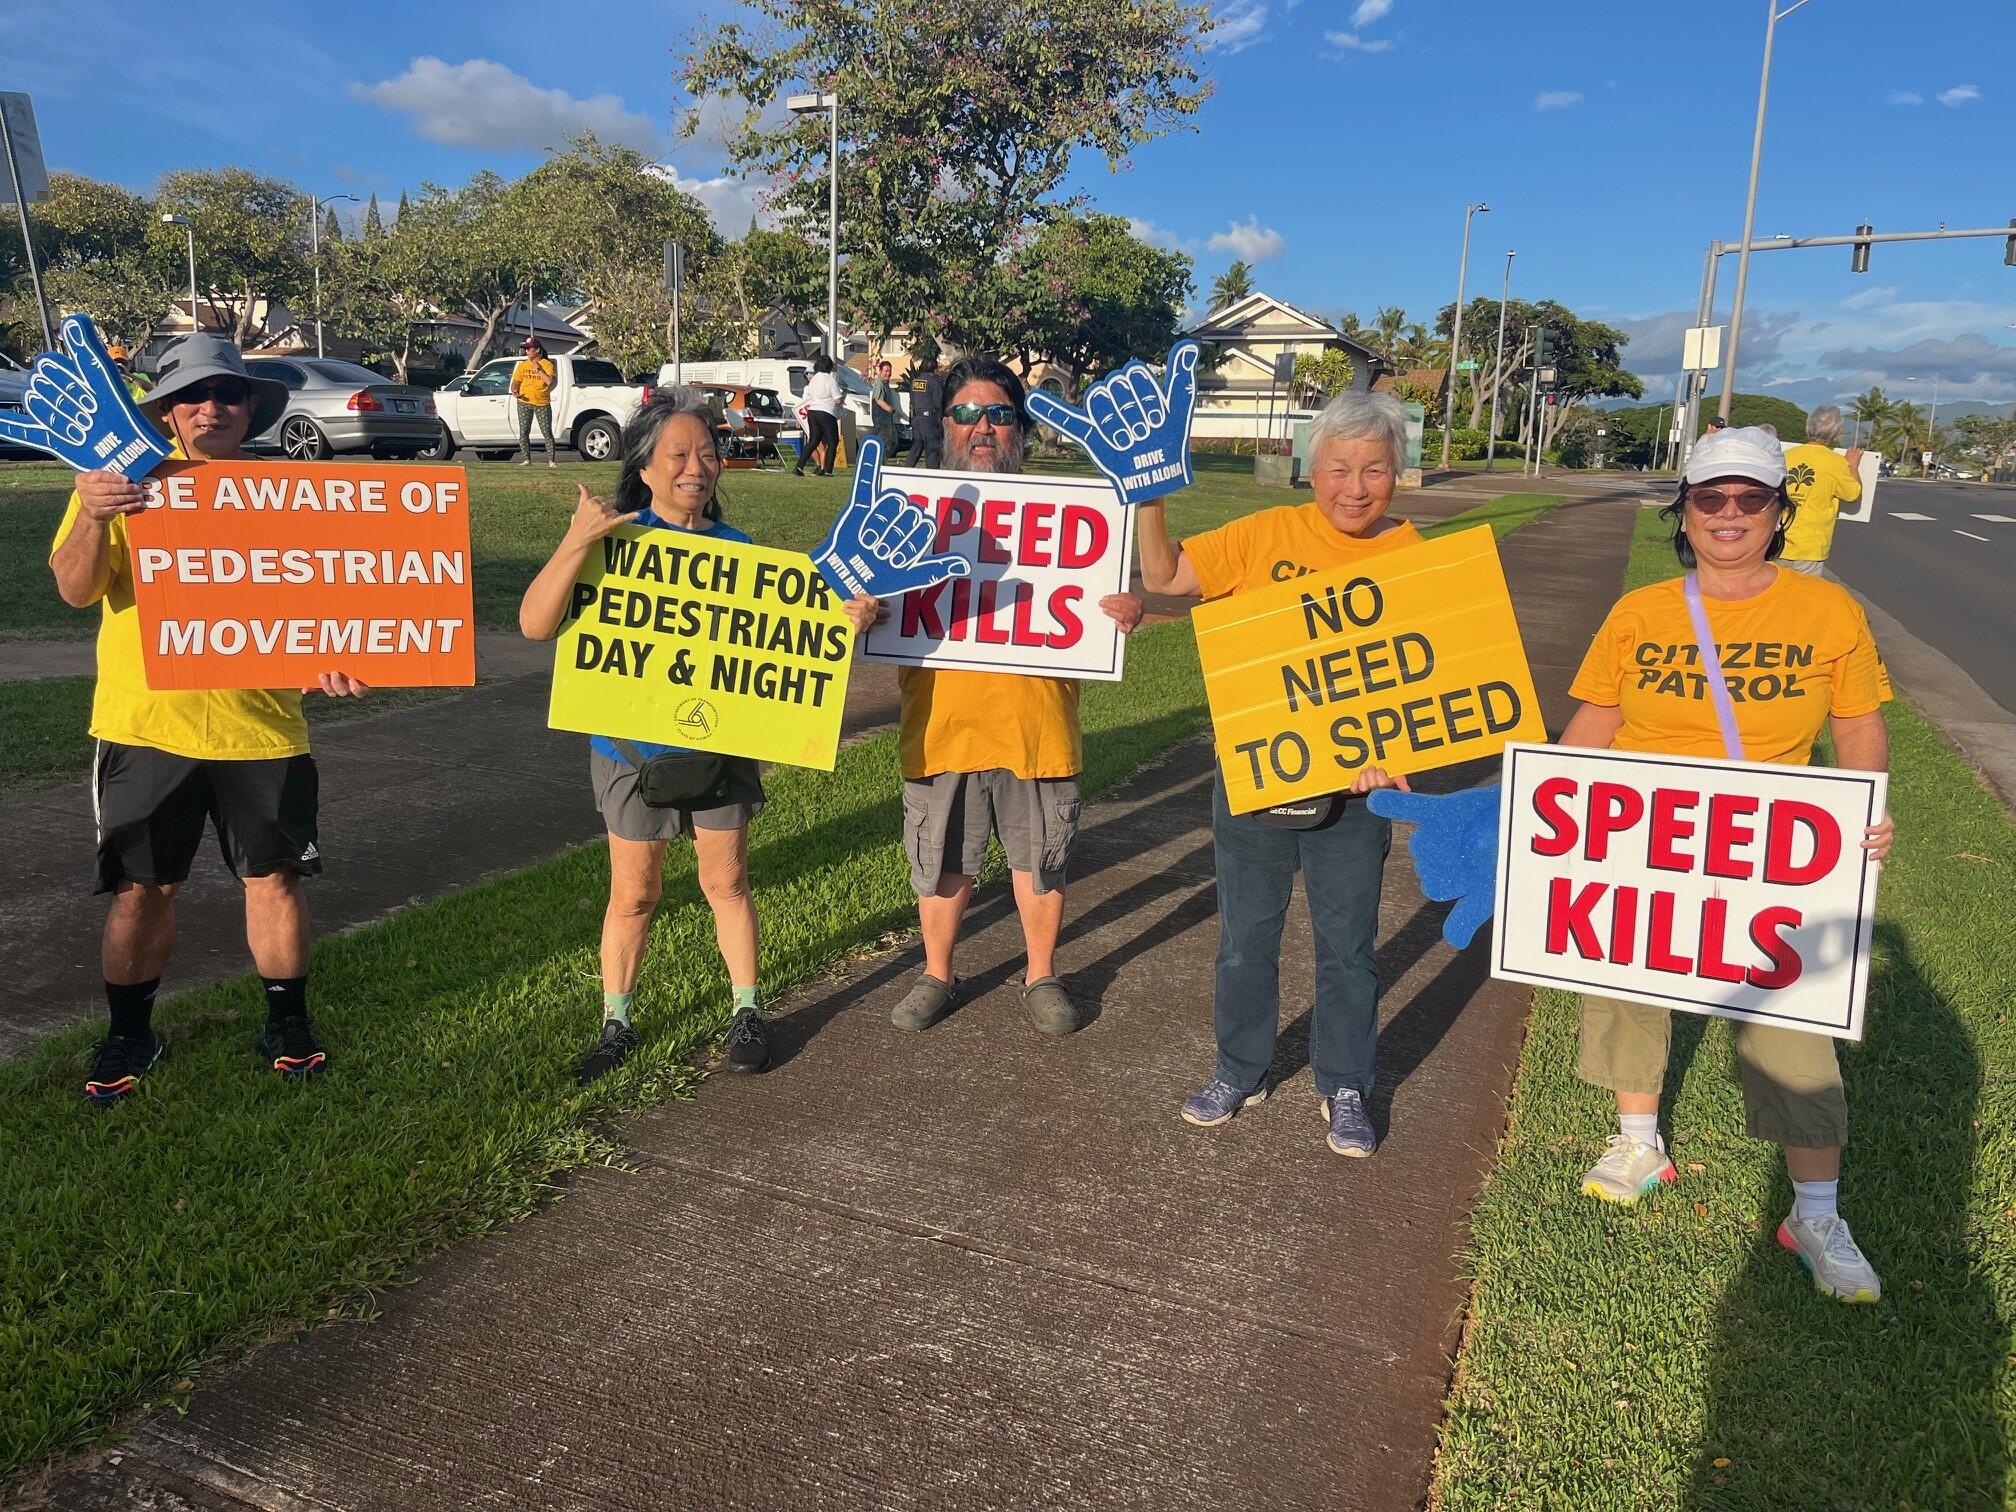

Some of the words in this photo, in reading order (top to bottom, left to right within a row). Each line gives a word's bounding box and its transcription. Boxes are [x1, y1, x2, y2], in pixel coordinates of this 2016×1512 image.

[93, 431, 122, 459] DRIVE
[116, 438, 150, 467] ALOHA
[1133, 448, 1165, 470] DRIVE
[141, 476, 198, 509] BE
[212, 476, 388, 512] AWARE
[400, 481, 460, 513] OF
[1122, 471, 1151, 490] WITH
[1151, 461, 1183, 484] ALOHA
[908, 494, 1109, 569] PEED
[137, 548, 465, 585] PEDESTRIAN
[603, 536, 740, 595] WATCH
[753, 562, 831, 611] FOR
[826, 552, 851, 580] WITH
[843, 575, 869, 596] ALO
[848, 553, 875, 583] DRIVE
[570, 582, 848, 663] PEDESTRIANS
[901, 577, 1084, 650] KILLS
[1300, 576, 1384, 640] NO
[157, 619, 464, 656] MOVEMENT
[575, 633, 655, 678] DAY
[668, 648, 697, 687] &
[710, 654, 833, 708] NIGHT
[1281, 632, 1435, 713] NEED
[1637, 669, 1806, 703] PATROL
[1235, 731, 1311, 790] TO
[1329, 680, 1522, 769] SPEED
[1287, 807, 1317, 815] Financial
[1530, 777, 1842, 886] SPEED
[1545, 877, 1803, 990] KILLS
